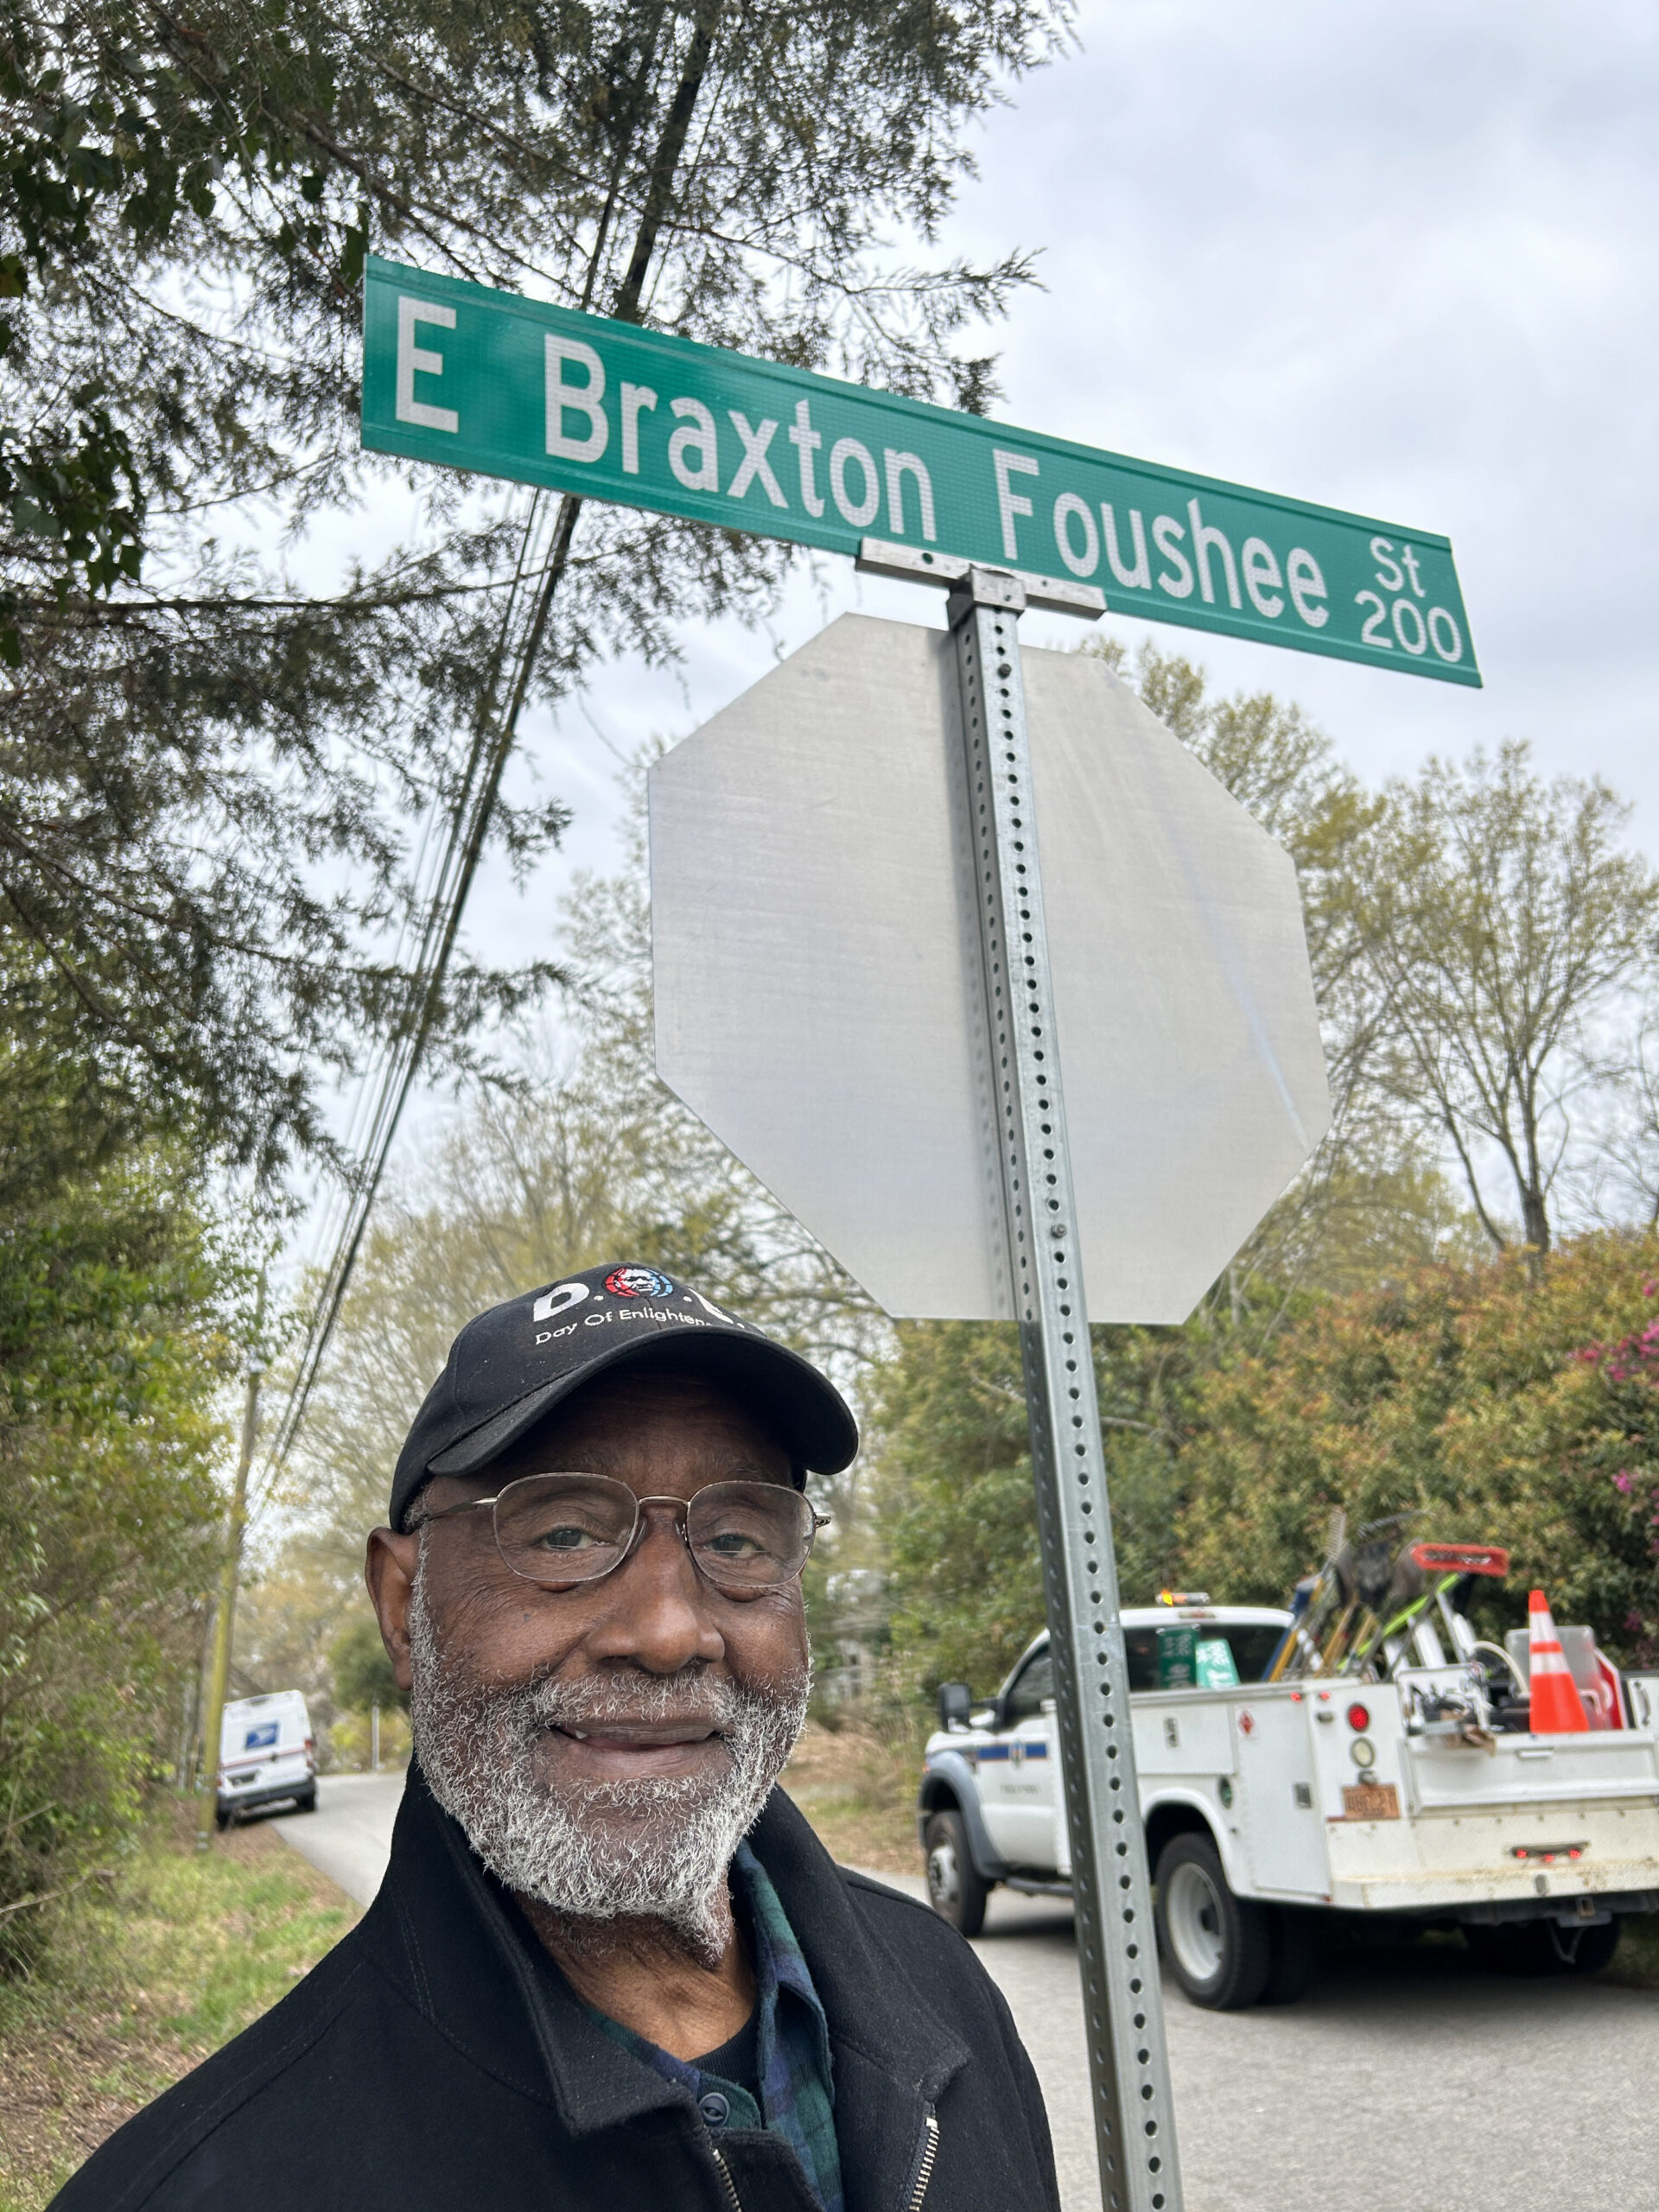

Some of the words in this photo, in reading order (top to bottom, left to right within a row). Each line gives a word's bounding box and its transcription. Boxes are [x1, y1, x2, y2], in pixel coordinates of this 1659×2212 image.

[395, 295, 460, 434] E
[543, 332, 938, 542] Braxton
[992, 448, 1331, 628] Foushee
[1370, 536, 1426, 598] St
[1353, 589, 1463, 664] 200
[535, 1323, 578, 1345] Day
[584, 1311, 613, 1326] Of
[619, 1306, 713, 1326] Enlighten
